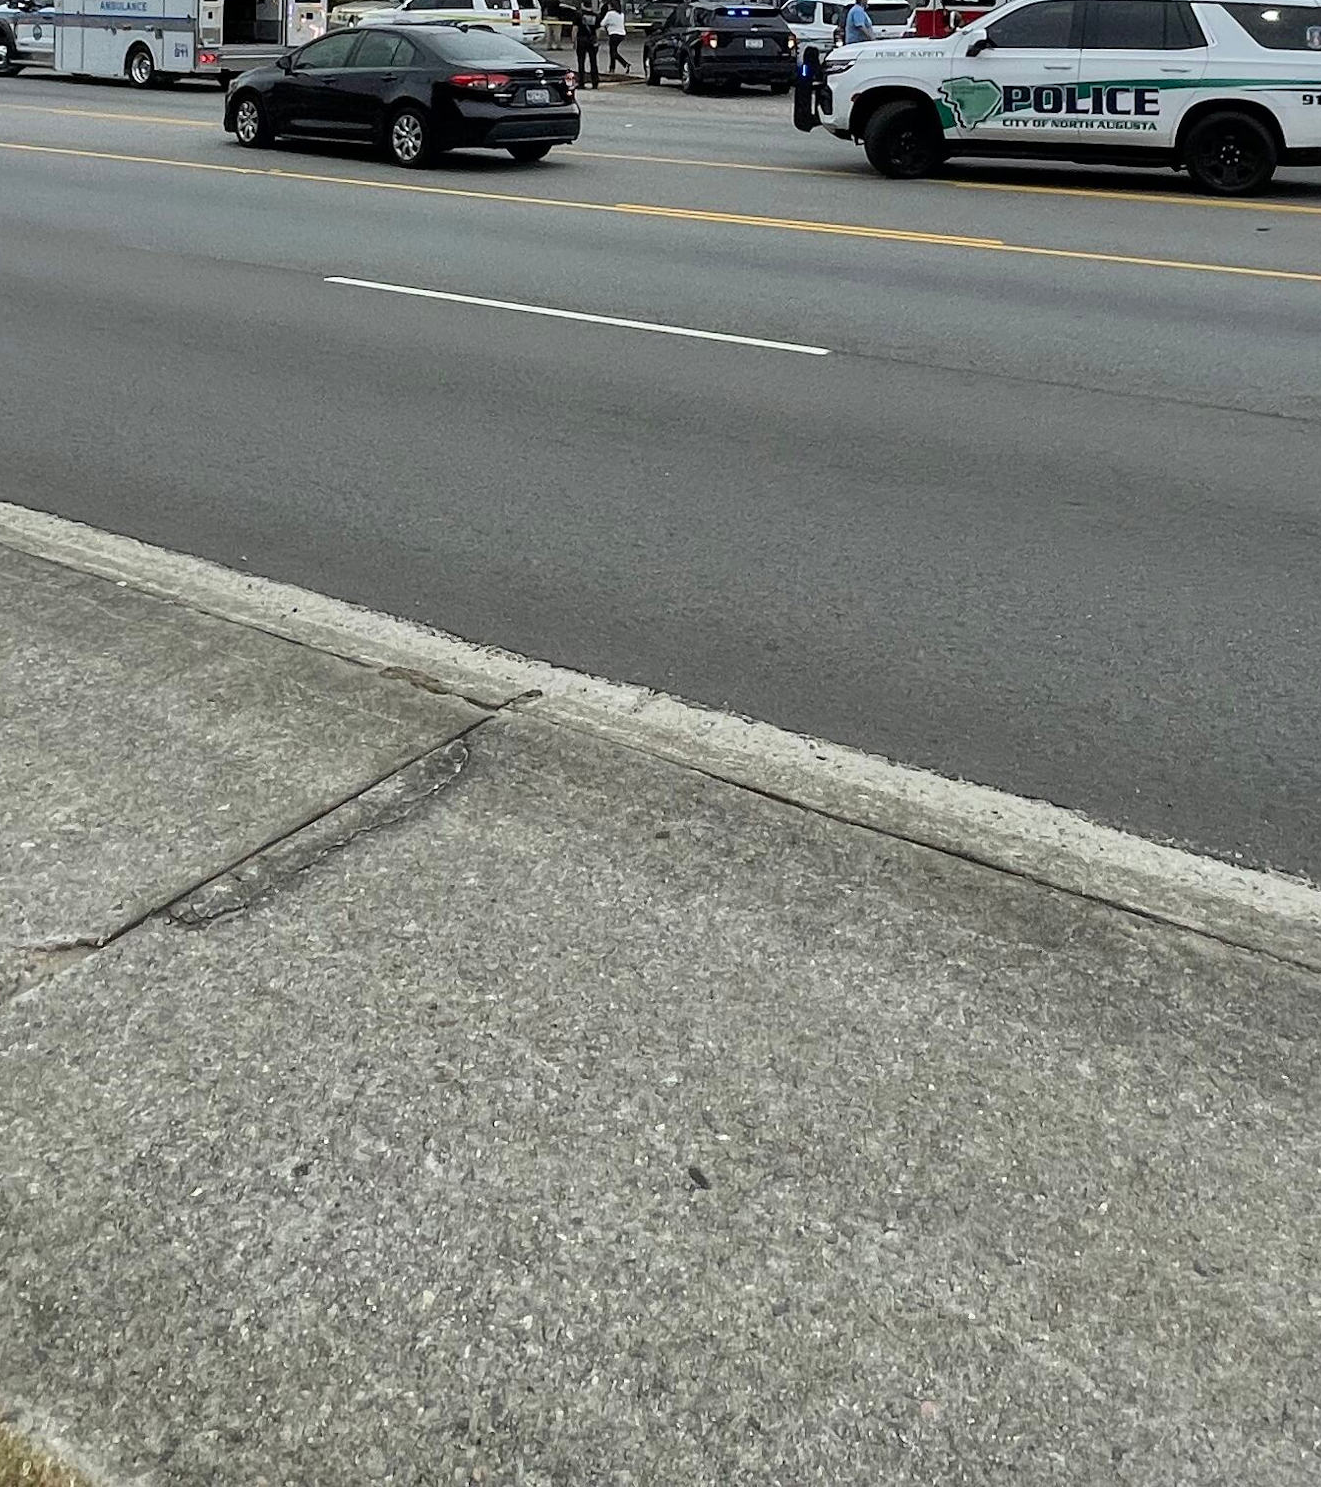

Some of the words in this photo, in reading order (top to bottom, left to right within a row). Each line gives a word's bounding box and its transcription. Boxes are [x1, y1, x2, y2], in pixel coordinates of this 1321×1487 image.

[99, 0, 148, 12] AMBULANCE
[1002, 85, 1161, 116] POLICE
[1001, 118, 1031, 128] CITY
[1032, 119, 1048, 128] OF
[1049, 119, 1094, 129] NORTH
[1096, 120, 1158, 131] AUGUSTA
